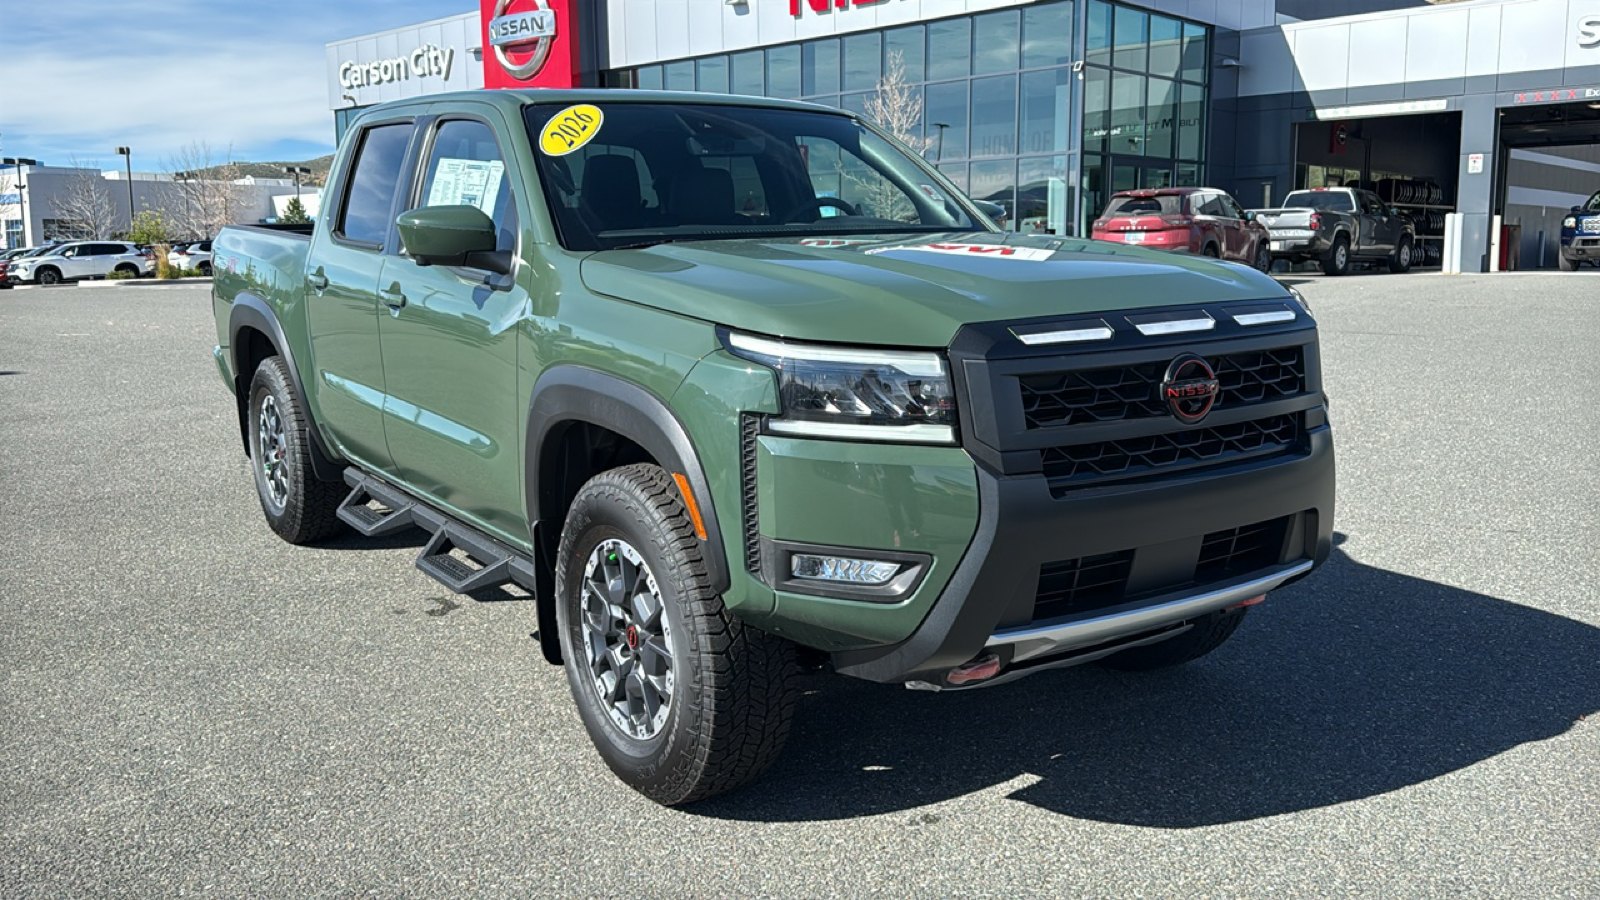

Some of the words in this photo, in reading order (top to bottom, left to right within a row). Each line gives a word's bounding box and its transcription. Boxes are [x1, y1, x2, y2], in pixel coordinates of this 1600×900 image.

[490, 16, 545, 39] NISSAN
[339, 60, 409, 89] Carson
[410, 43, 454, 81] City
[550, 108, 594, 148] 2026
